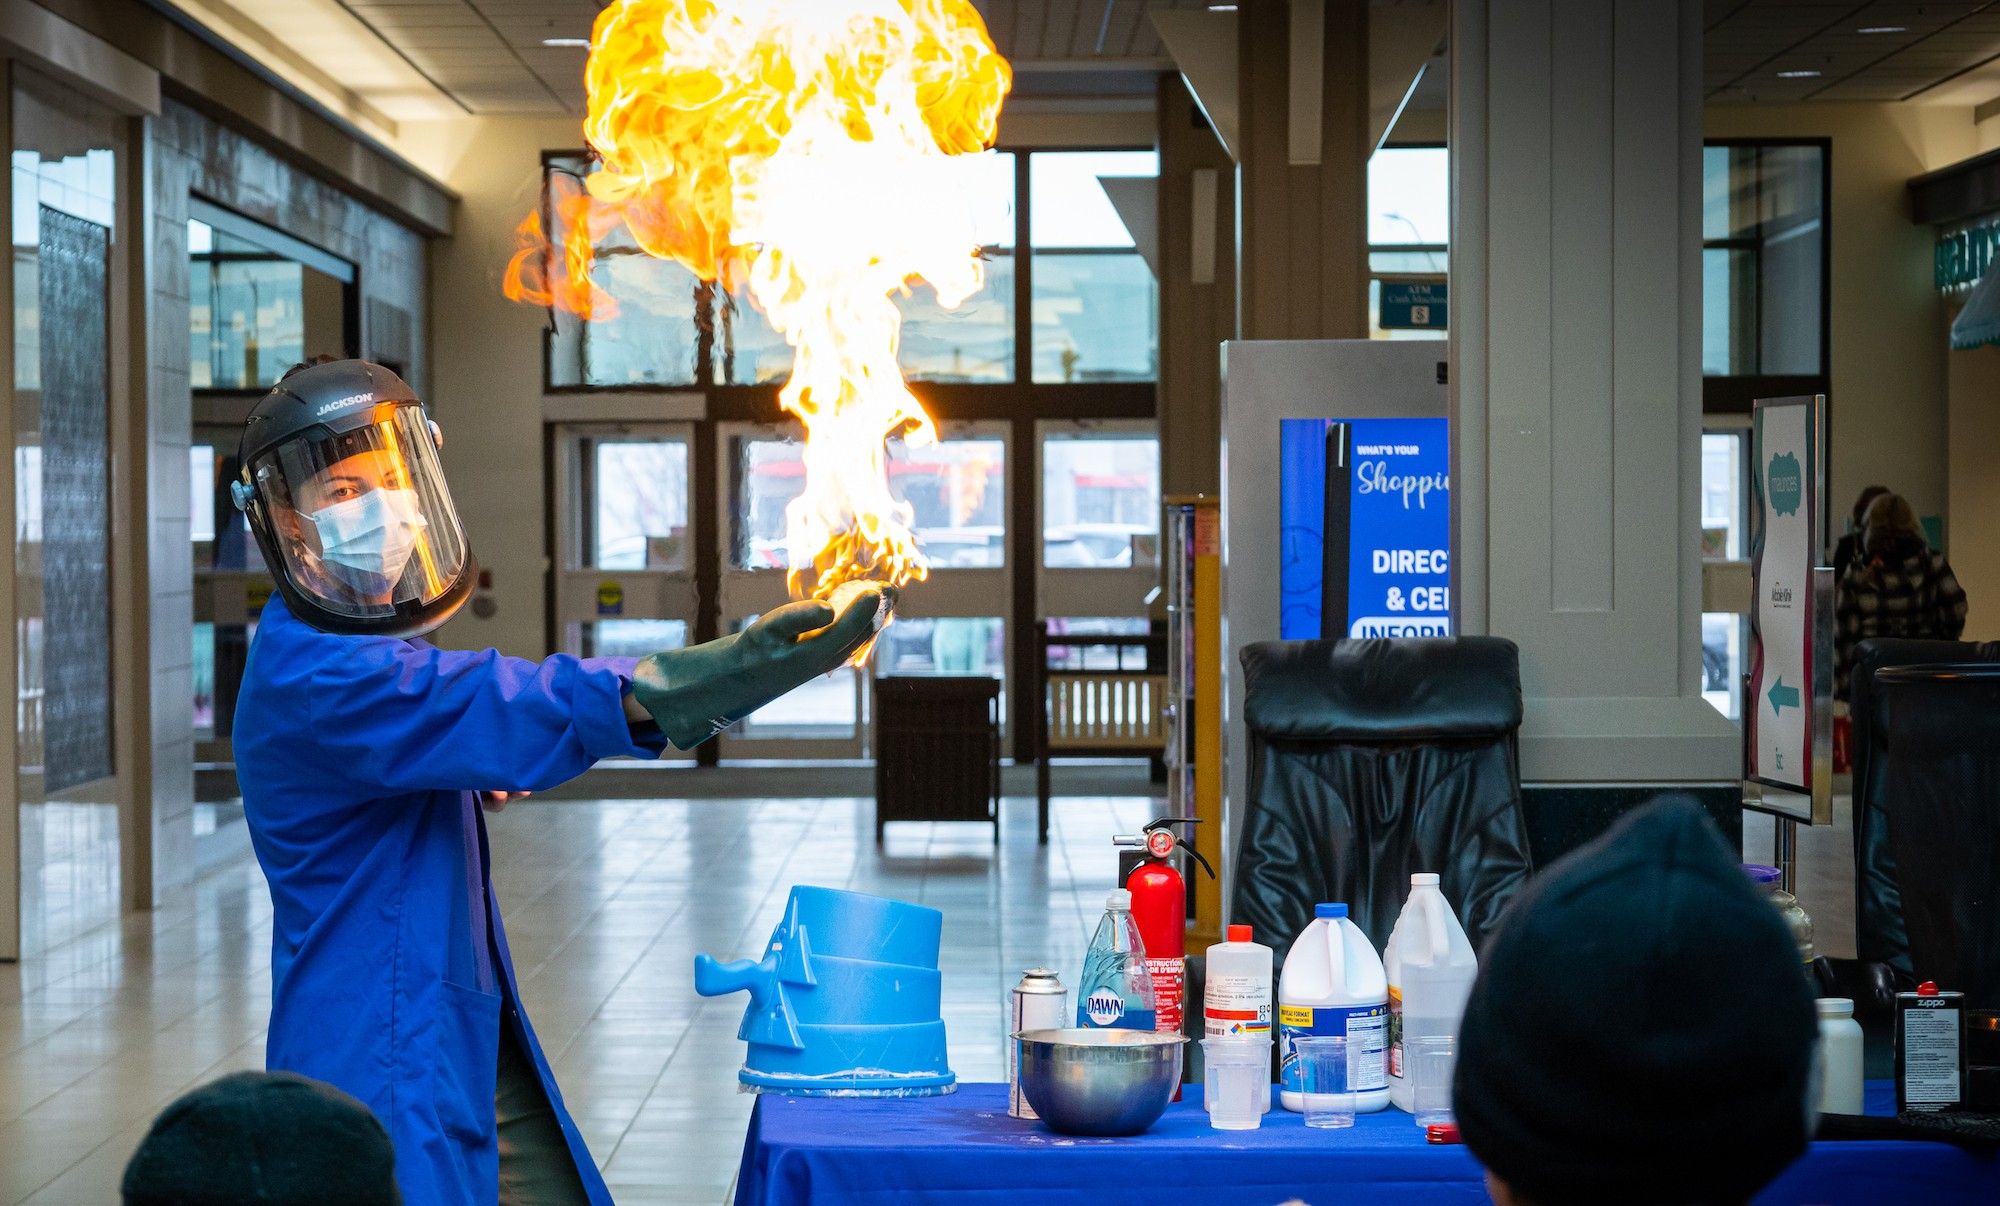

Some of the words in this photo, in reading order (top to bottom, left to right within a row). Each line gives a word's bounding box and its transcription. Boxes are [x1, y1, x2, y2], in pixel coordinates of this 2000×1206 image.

[316, 393, 373, 417] JACKSON
[1356, 445, 1394, 456] WHAT'S
[1394, 445, 1420, 456] YOUR
[1372, 549, 1449, 574] DIREC
[1385, 586, 1406, 611] &
[1087, 997, 1124, 1016] DAWN
